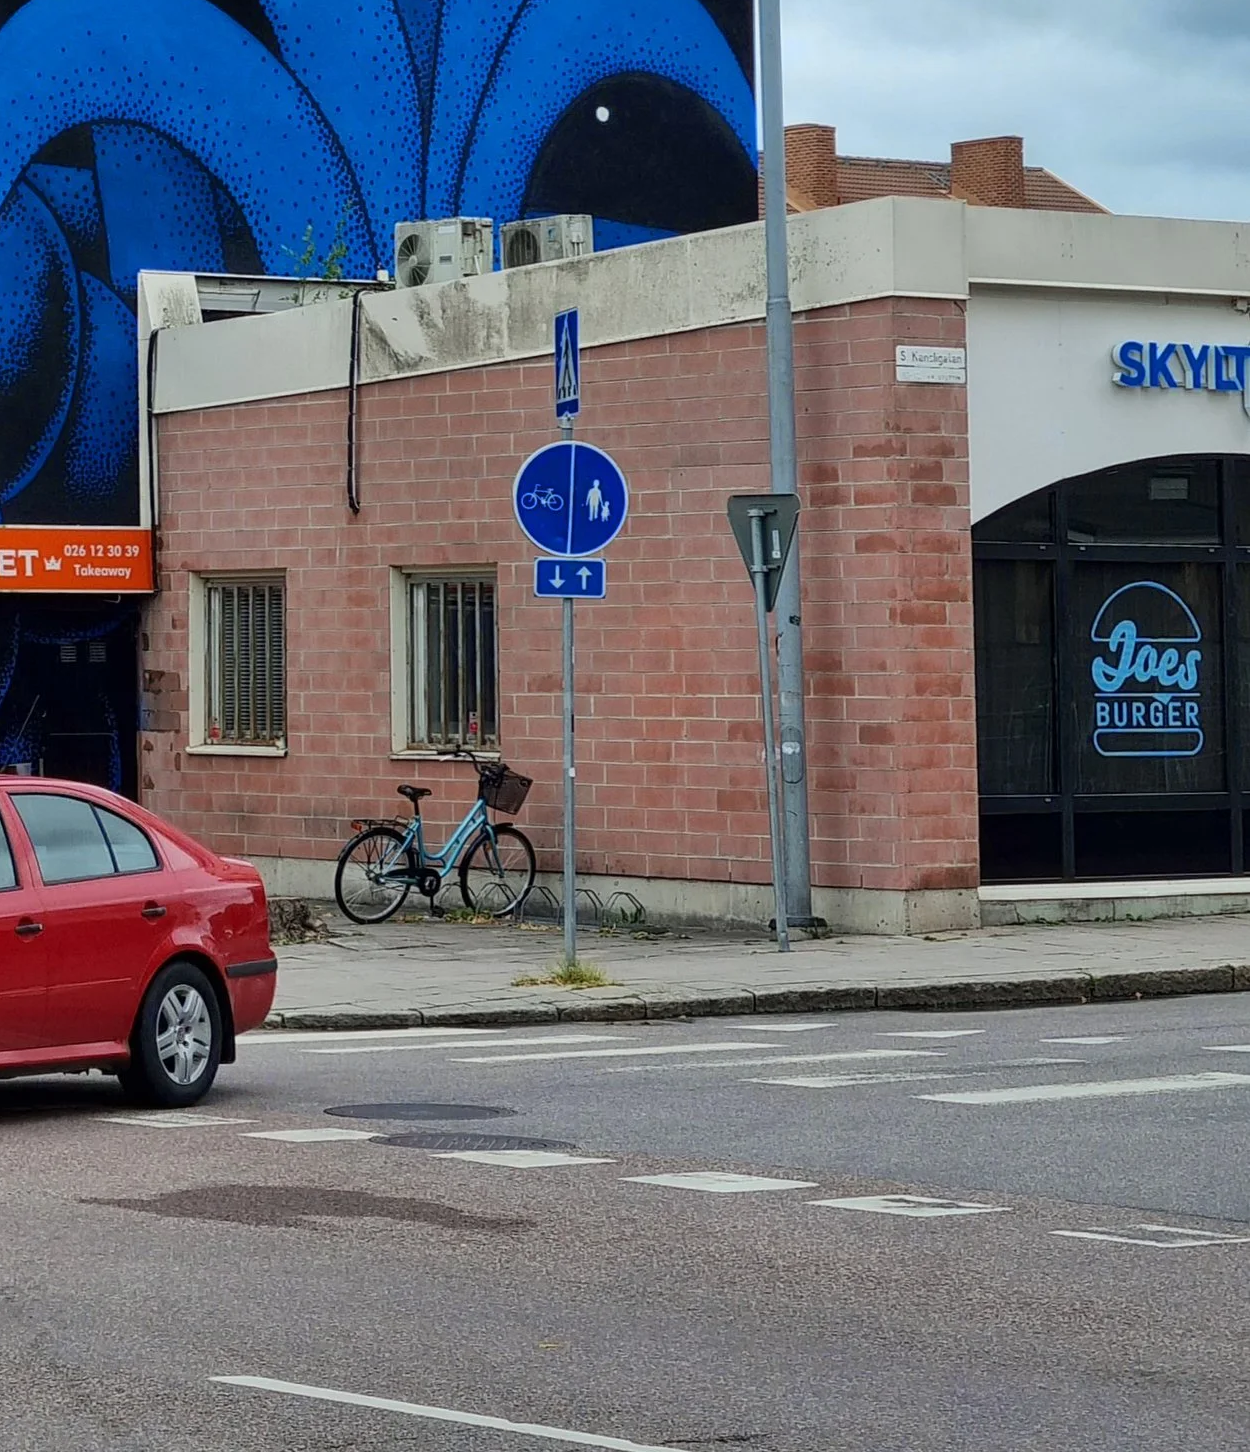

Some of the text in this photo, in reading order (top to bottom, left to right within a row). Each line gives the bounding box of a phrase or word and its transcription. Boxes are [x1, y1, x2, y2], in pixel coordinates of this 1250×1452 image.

[1112, 340, 1250, 391] SKYLT
[63, 544, 140, 557] 026 12 30 39
[73, 563, 132, 580] Takeaway
[1096, 701, 1199, 727] BURGER
